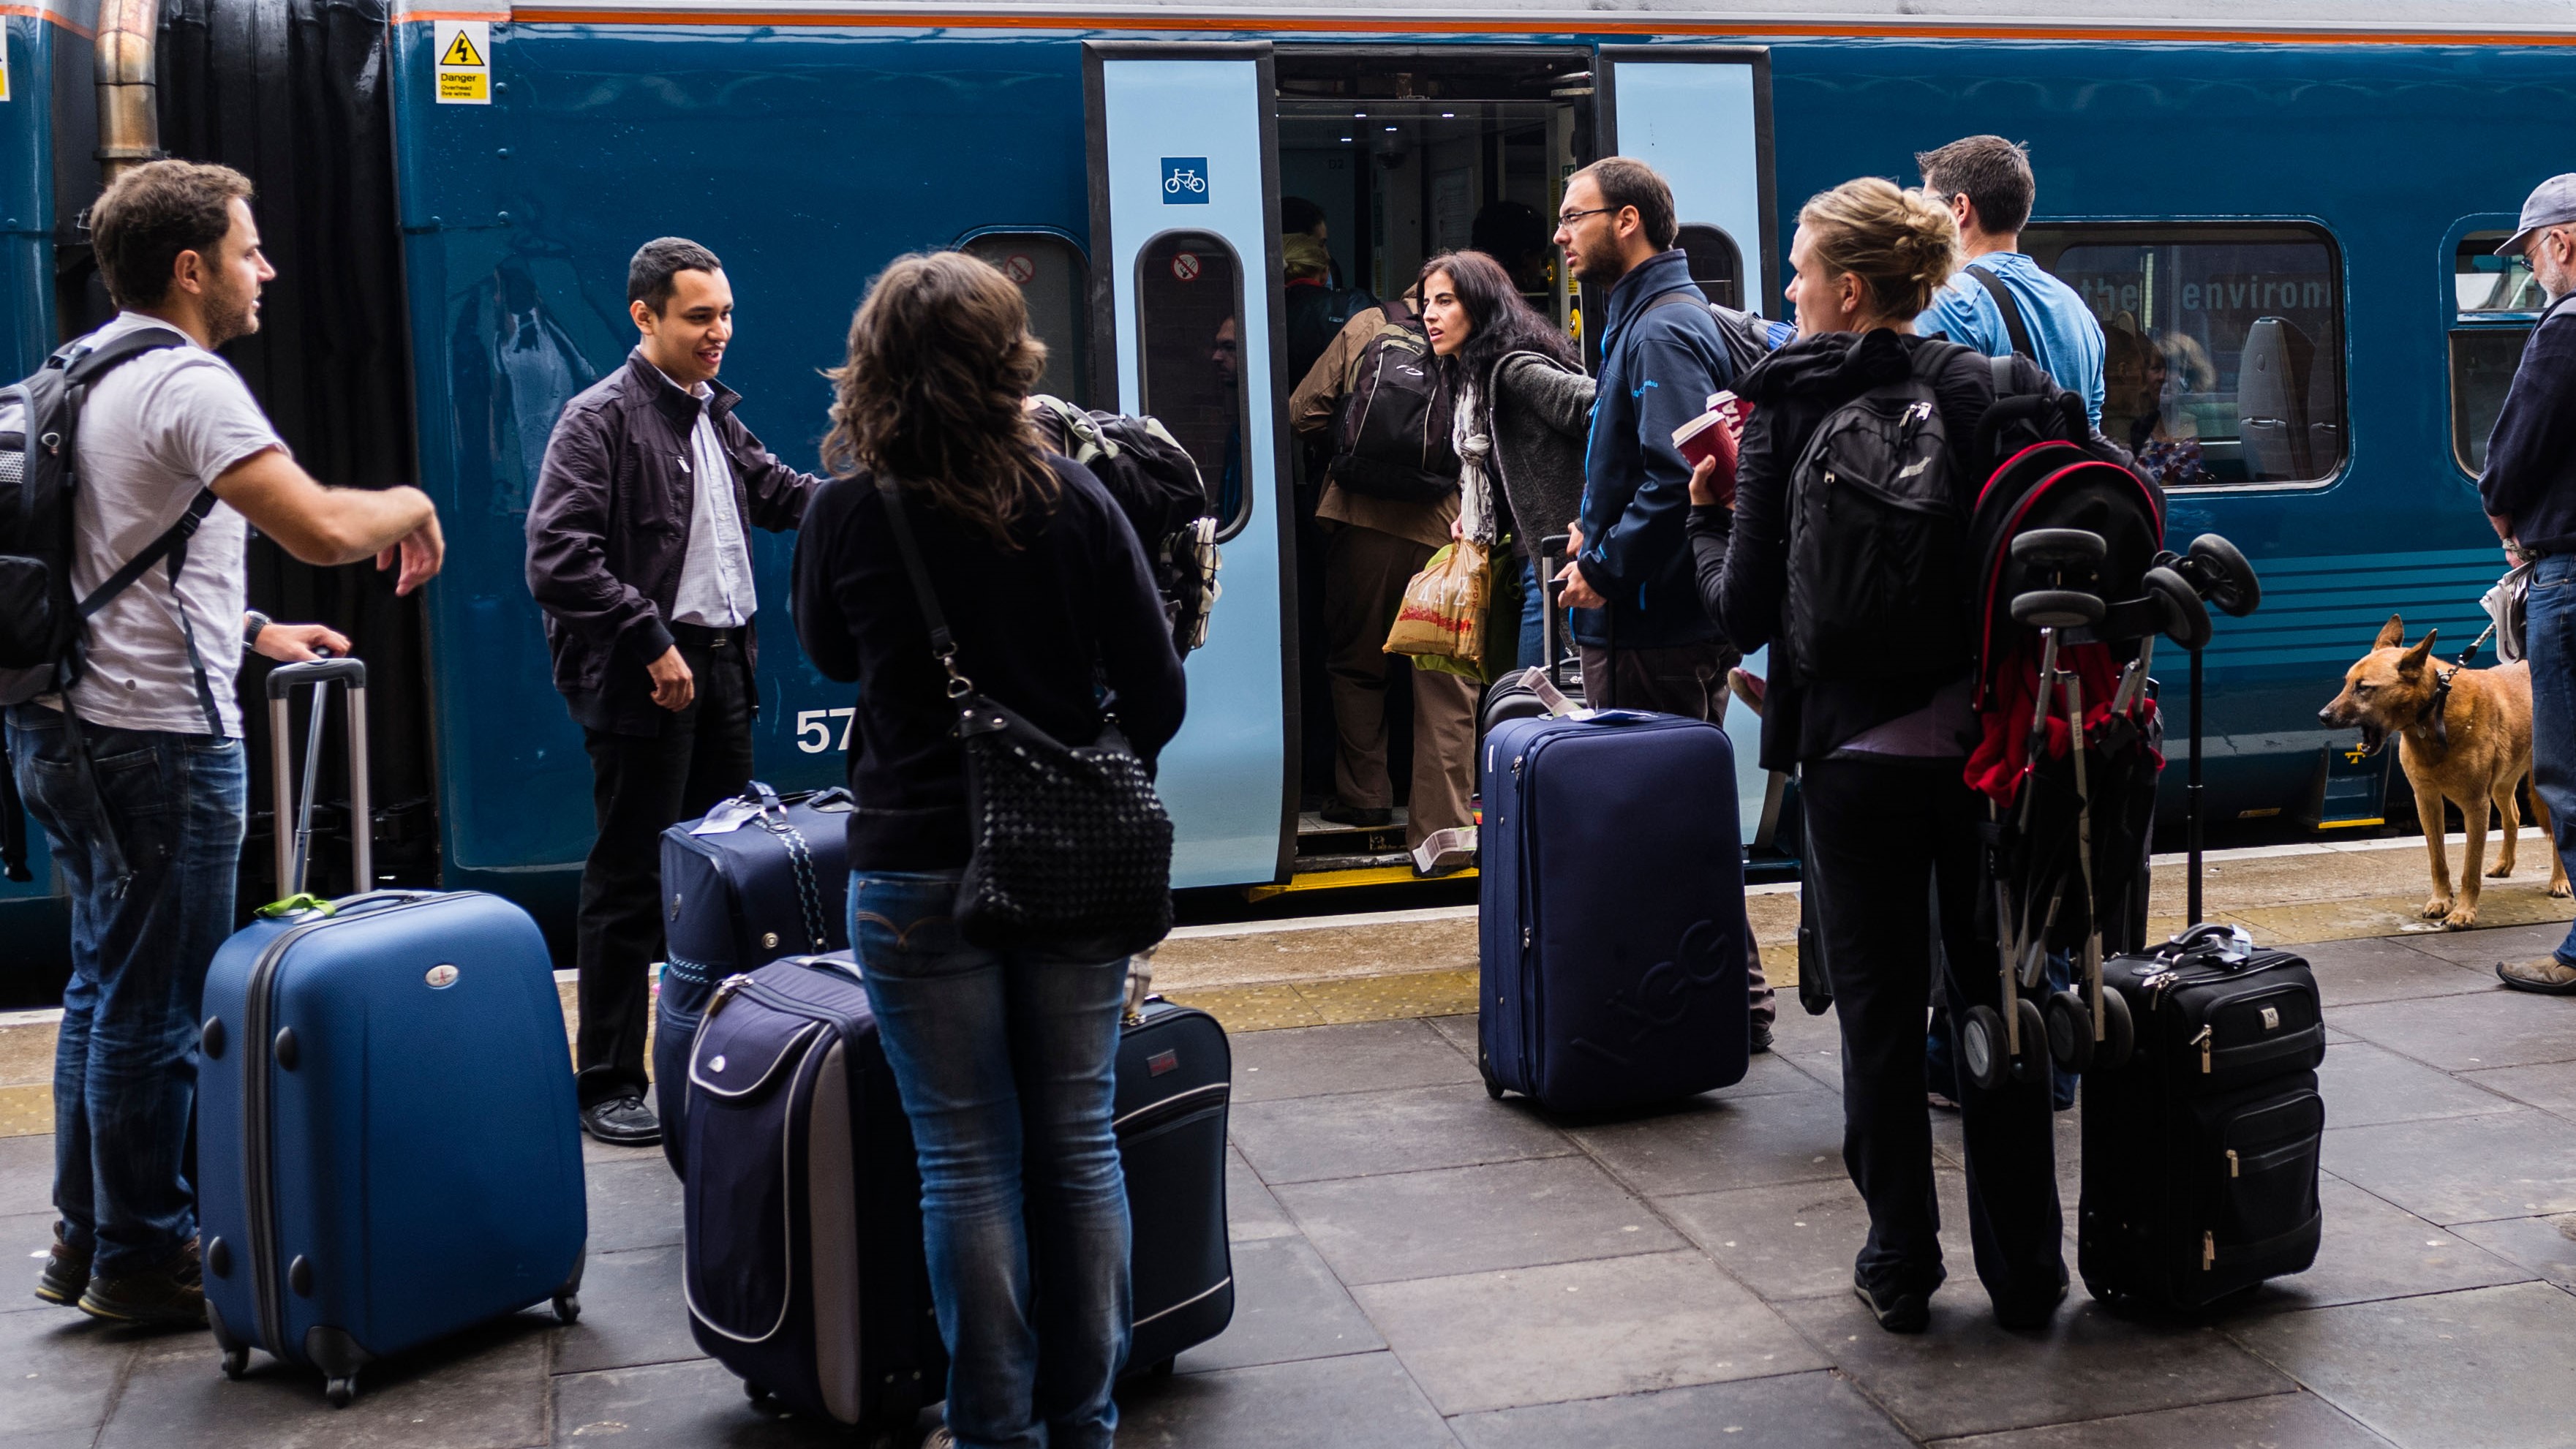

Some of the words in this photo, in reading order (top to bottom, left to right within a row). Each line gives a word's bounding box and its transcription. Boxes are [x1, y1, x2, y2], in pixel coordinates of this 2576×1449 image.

[441, 73, 476, 83] Danger
[1328, 159, 1344, 169] D2
[2079, 279, 2139, 311] the
[2183, 276, 2331, 310] environ
[796, 707, 856, 753] 57
